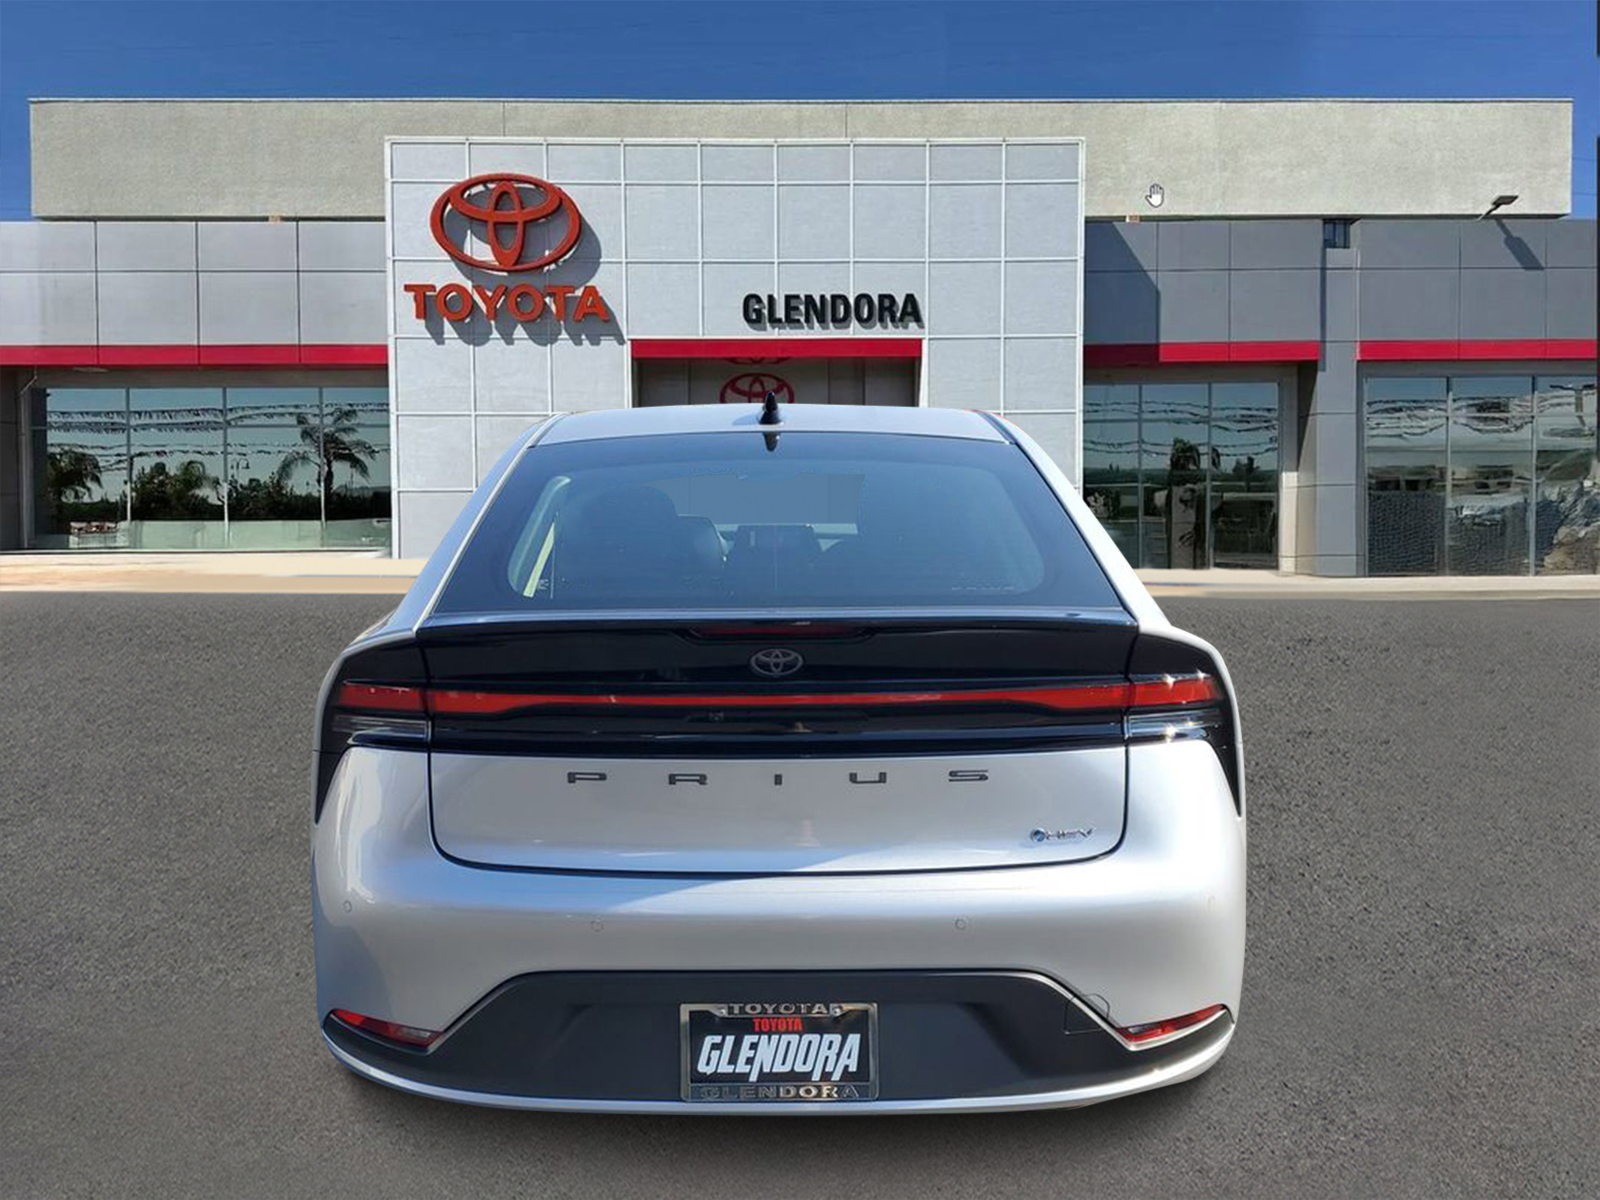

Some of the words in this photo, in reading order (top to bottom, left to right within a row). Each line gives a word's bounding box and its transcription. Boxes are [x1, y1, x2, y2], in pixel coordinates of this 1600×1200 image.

[404, 284, 610, 323] TOYOTA
[742, 293, 923, 325] GLENDORA
[567, 769, 989, 785] PRIUS
[731, 1003, 828, 1015] TOYOTA
[753, 1018, 802, 1032] TOYOTA
[697, 1033, 861, 1082] GLENDORA
[701, 1085, 859, 1099] GLENDORA
